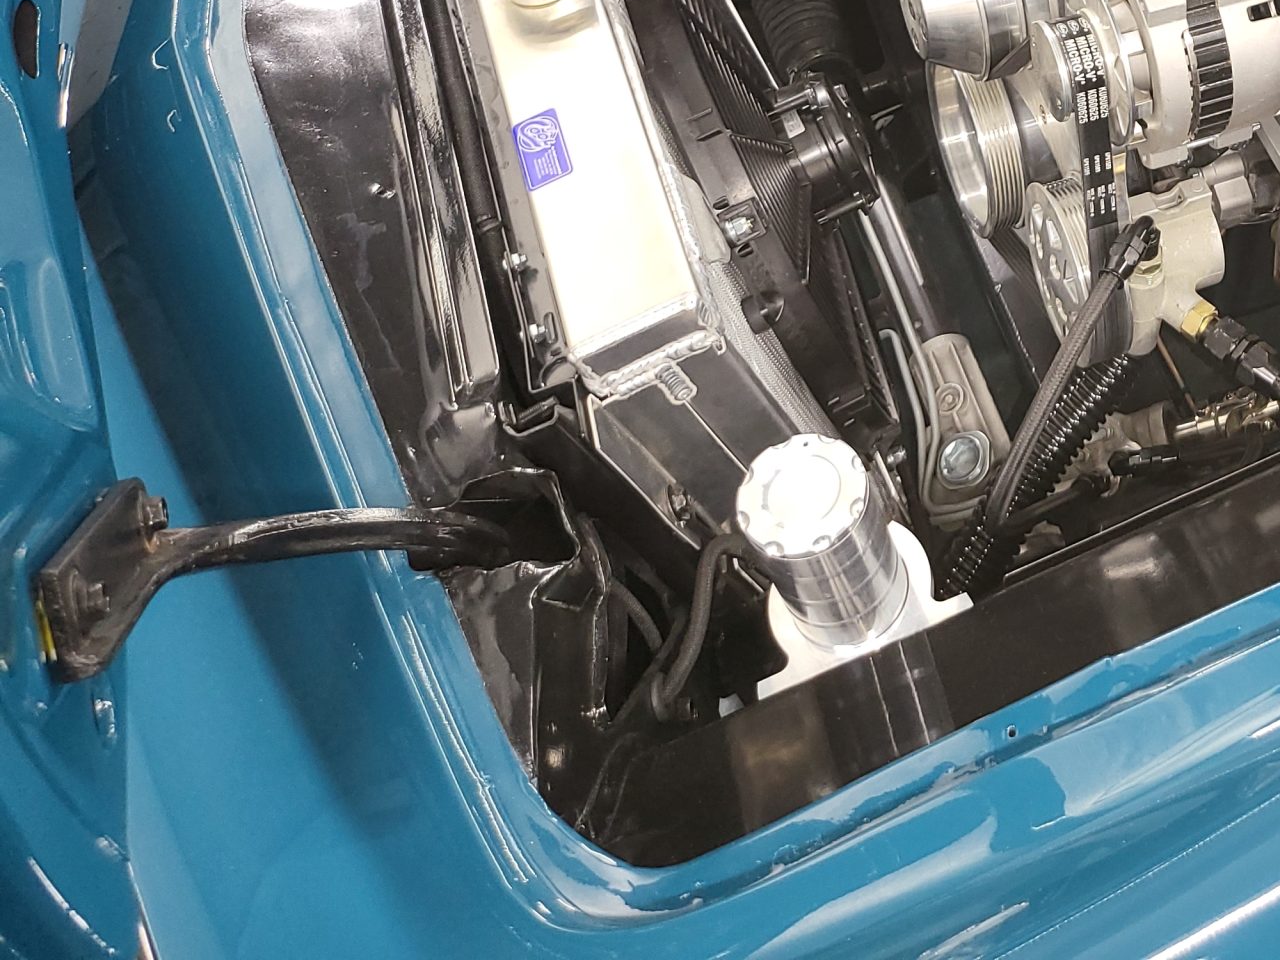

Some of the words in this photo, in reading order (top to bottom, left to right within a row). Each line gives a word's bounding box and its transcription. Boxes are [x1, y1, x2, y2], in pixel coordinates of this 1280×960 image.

[1066, 40, 1086, 85] MICRO-V
[1076, 92, 1088, 124] K060625
[1078, 36, 1096, 82] MICRO-V
[1087, 89, 1098, 121] K060625
[1098, 86, 1109, 118] K060625
